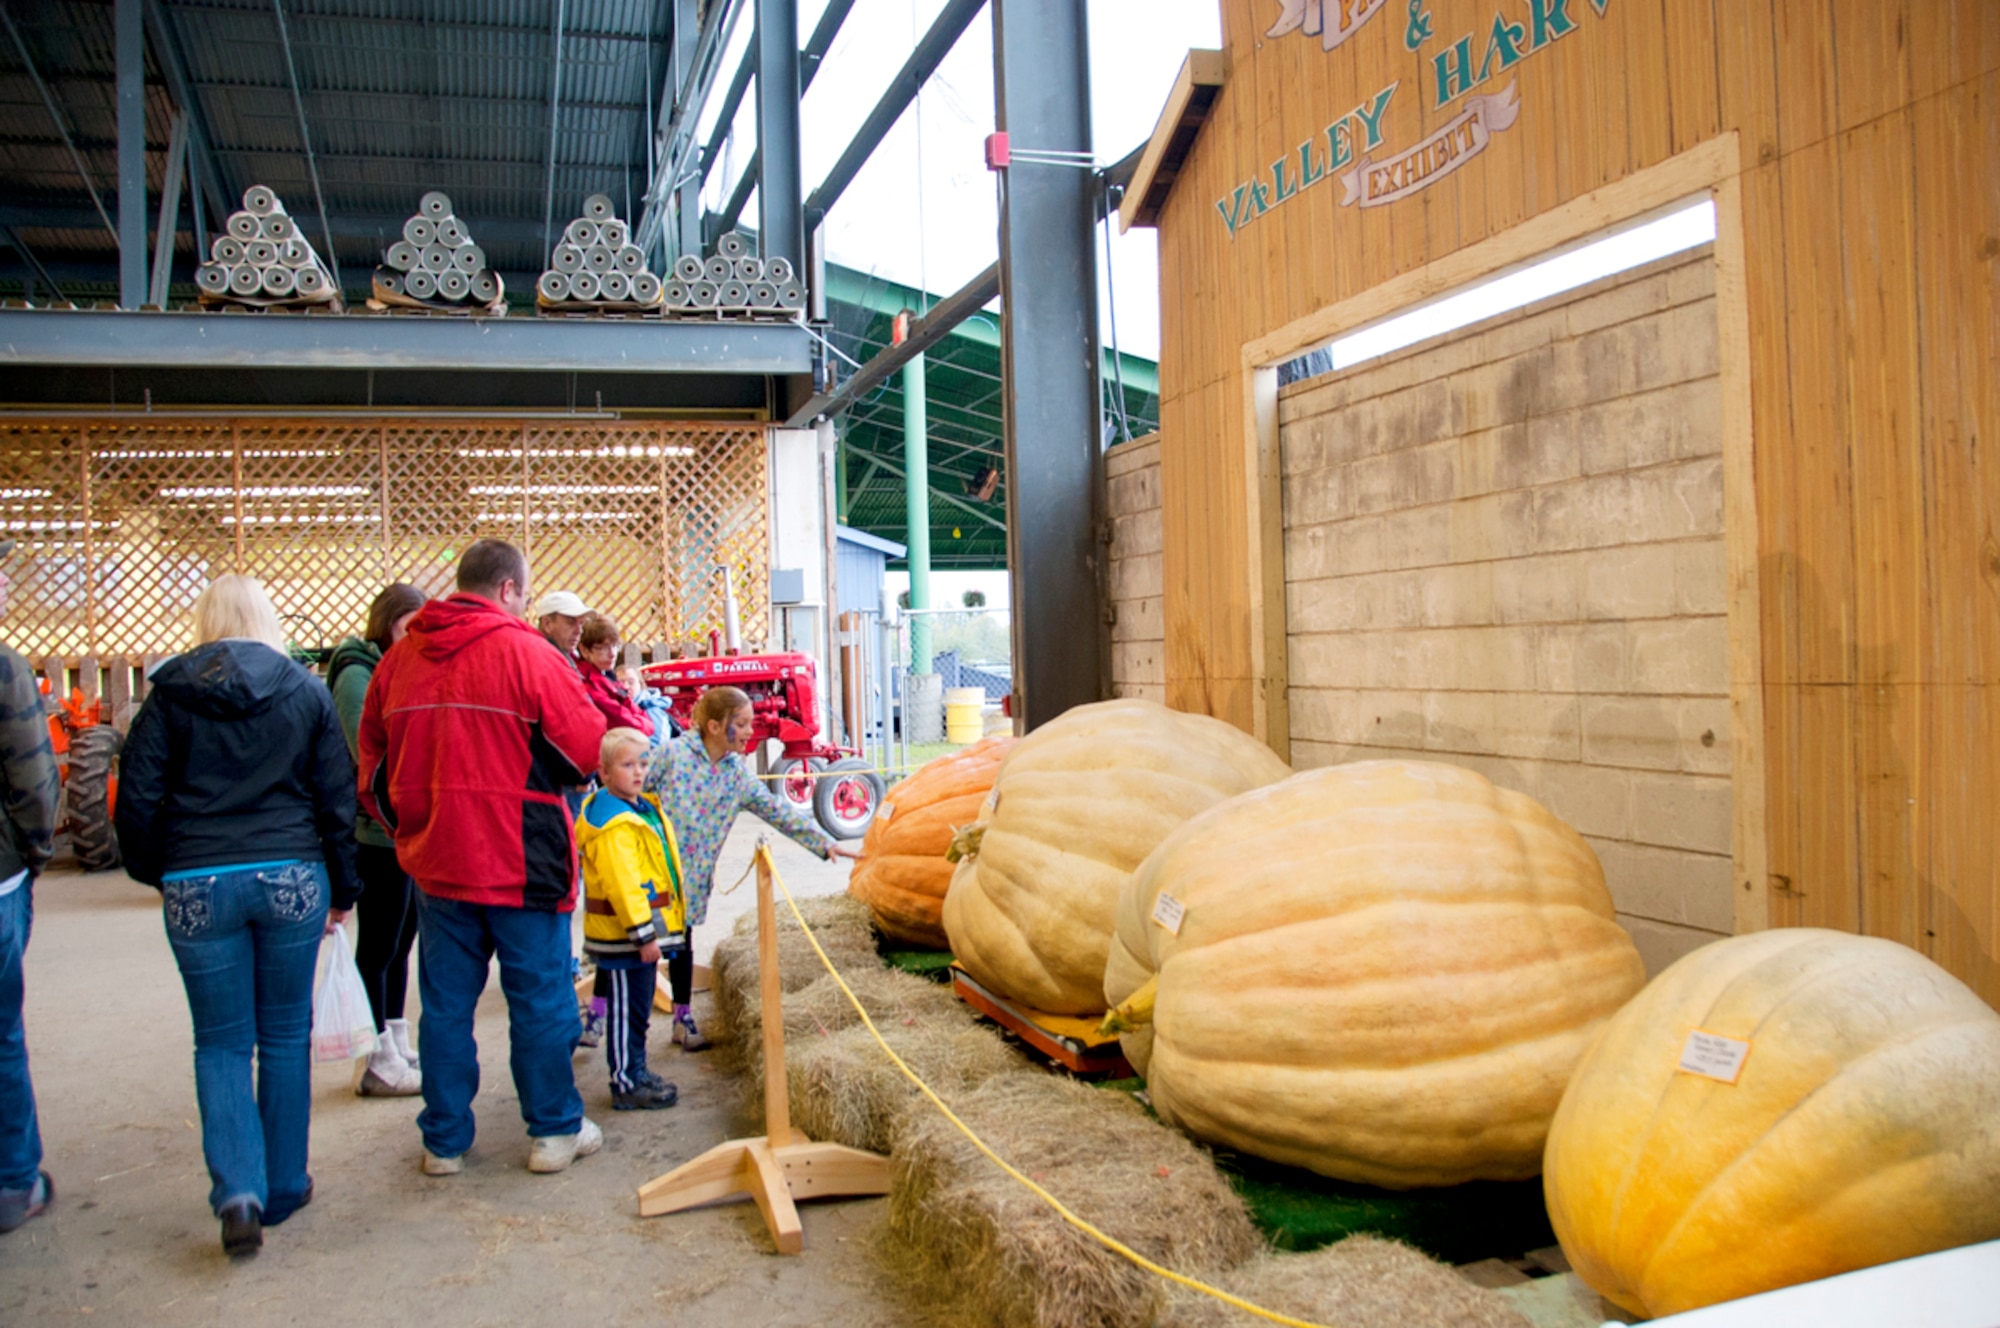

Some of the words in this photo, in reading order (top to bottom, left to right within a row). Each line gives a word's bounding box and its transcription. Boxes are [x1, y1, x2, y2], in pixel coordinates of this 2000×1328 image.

[1405, 0, 1434, 51] &
[1217, 80, 1400, 240] VALLEY
[1431, 0, 1609, 112] HAR
[1368, 112, 1479, 200] EXHIBIT
[724, 662, 769, 672] FARMALL
